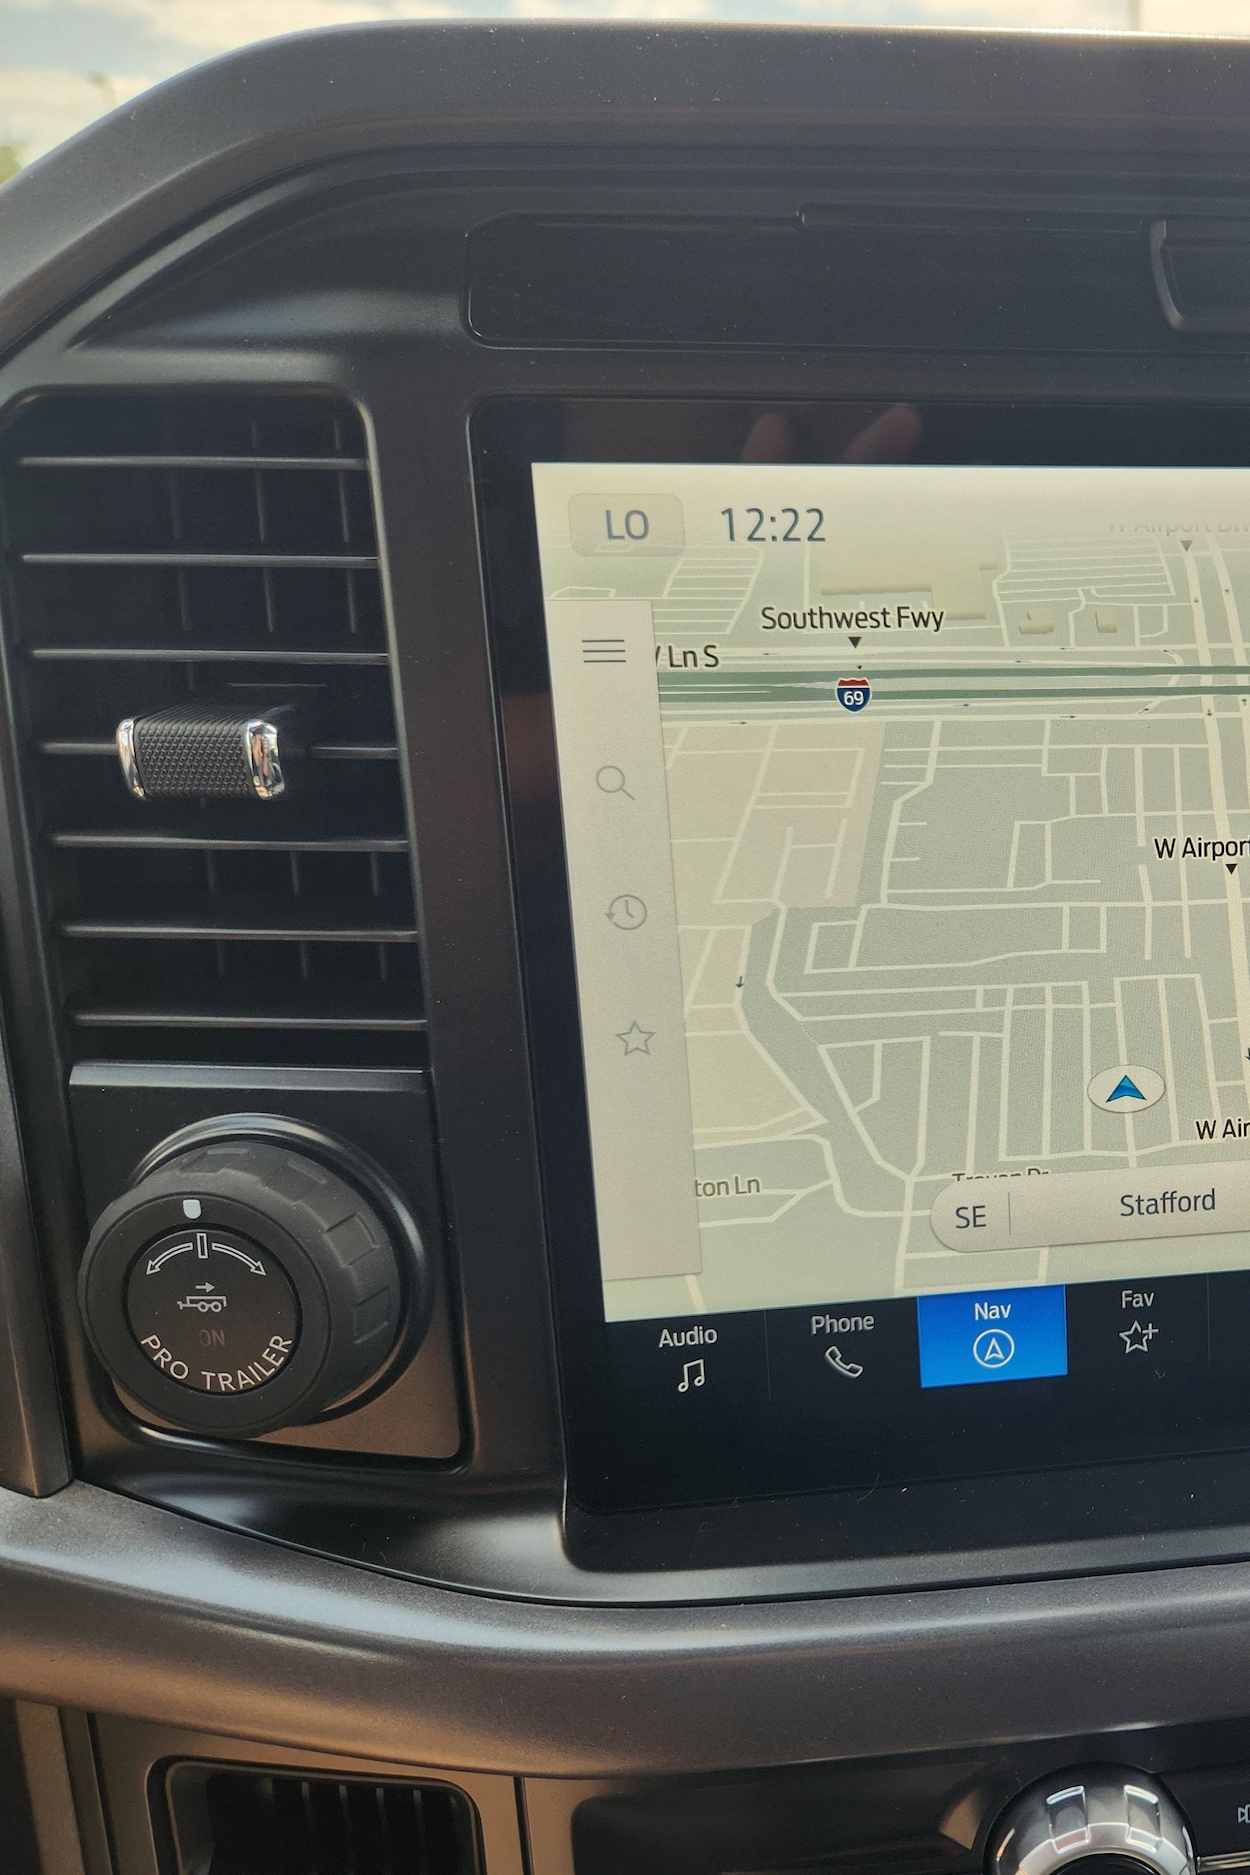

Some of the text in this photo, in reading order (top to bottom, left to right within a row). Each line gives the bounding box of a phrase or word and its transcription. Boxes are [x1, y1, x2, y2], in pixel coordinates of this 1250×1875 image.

[604, 509, 650, 541] LO
[720, 507, 826, 543] 12:22
[761, 606, 945, 633] Southwest Fwy
[668, 645, 698, 668] Ln
[703, 644, 720, 668] S
[843, 690, 865, 707] 69
[1154, 837, 1176, 859] W
[1195, 1119, 1217, 1140] W
[735, 1175, 760, 1195] Ln
[1120, 1188, 1216, 1217] Stafford
[955, 1205, 987, 1229] SE
[1121, 1290, 1155, 1309] Fav
[811, 1312, 875, 1336] Phone
[974, 1302, 1011, 1322] Nav
[658, 1324, 718, 1349] Audio
[140, 1334, 293, 1391] PRO TRAILER
